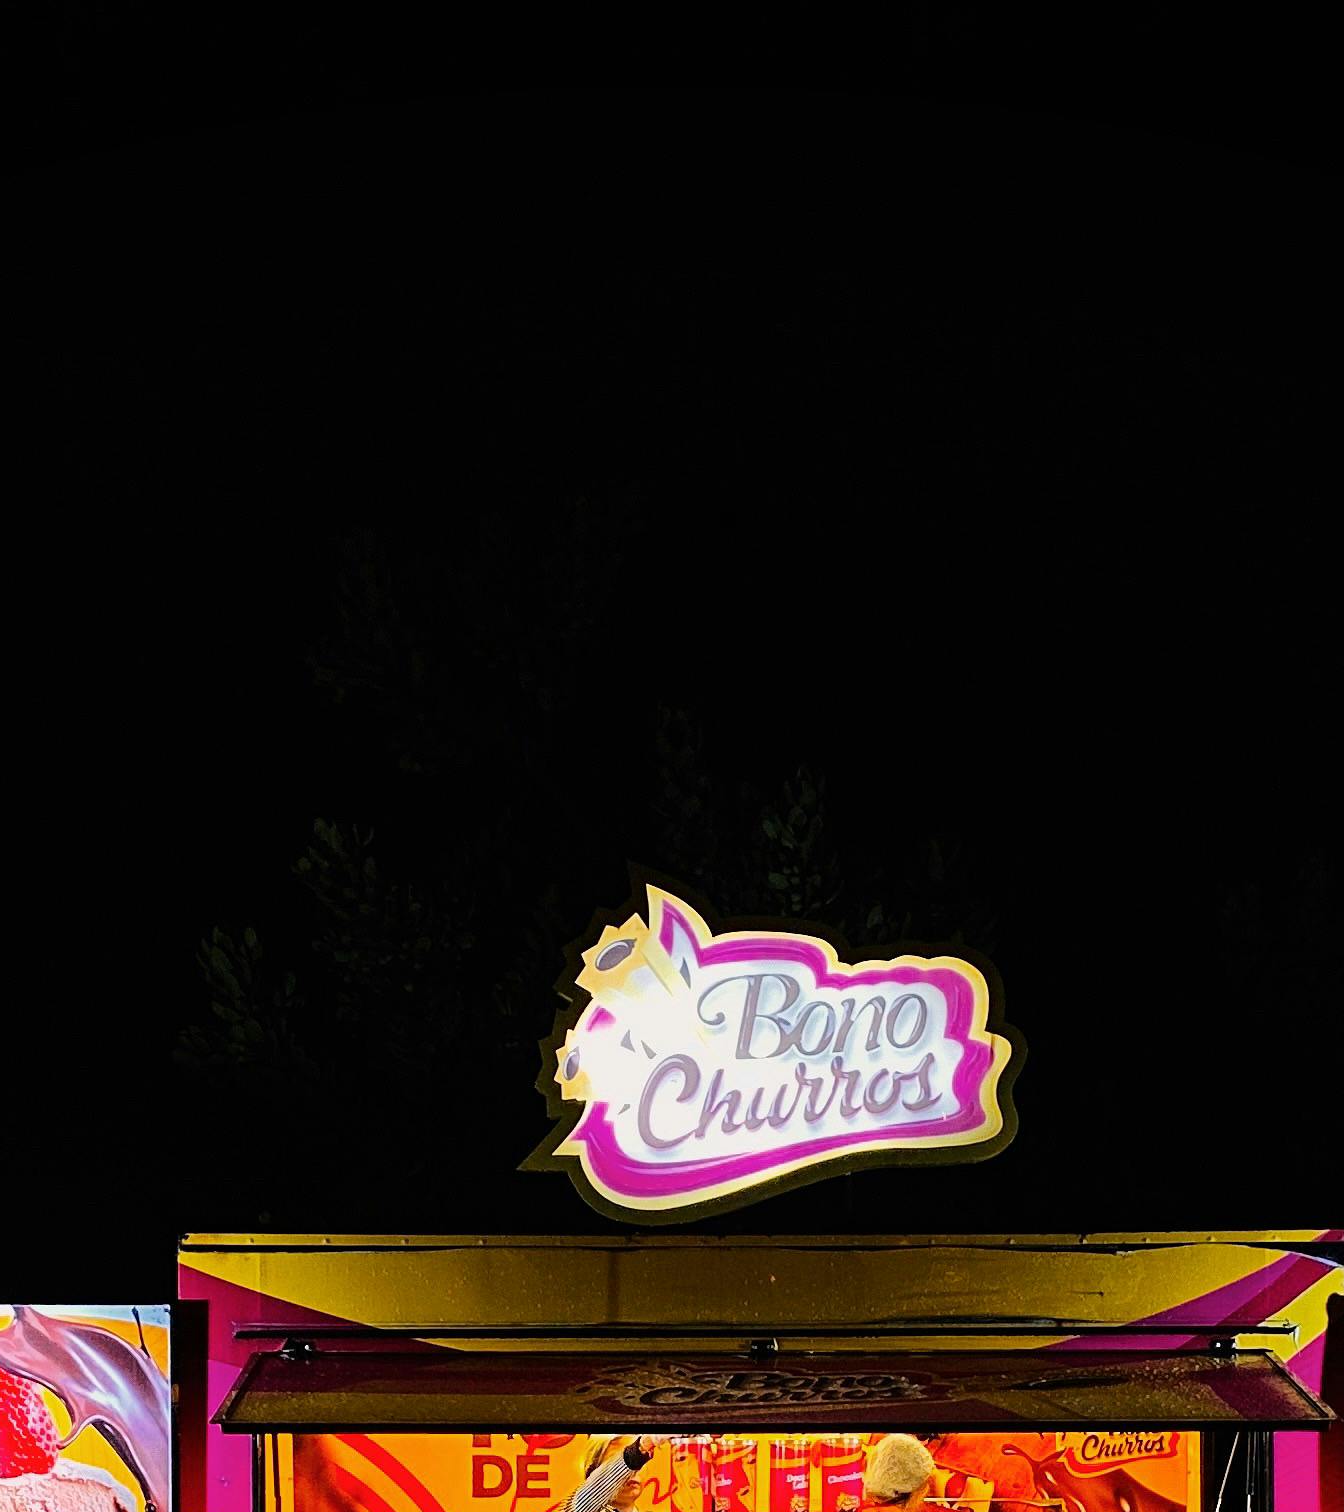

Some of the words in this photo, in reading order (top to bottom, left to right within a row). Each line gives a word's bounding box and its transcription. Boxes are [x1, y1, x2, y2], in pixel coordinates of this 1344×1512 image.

[698, 973, 927, 1060] Bono
[638, 1054, 942, 1150] Churros
[472, 1455, 551, 1498] DE
[1081, 1434, 1165, 1461] Churros
